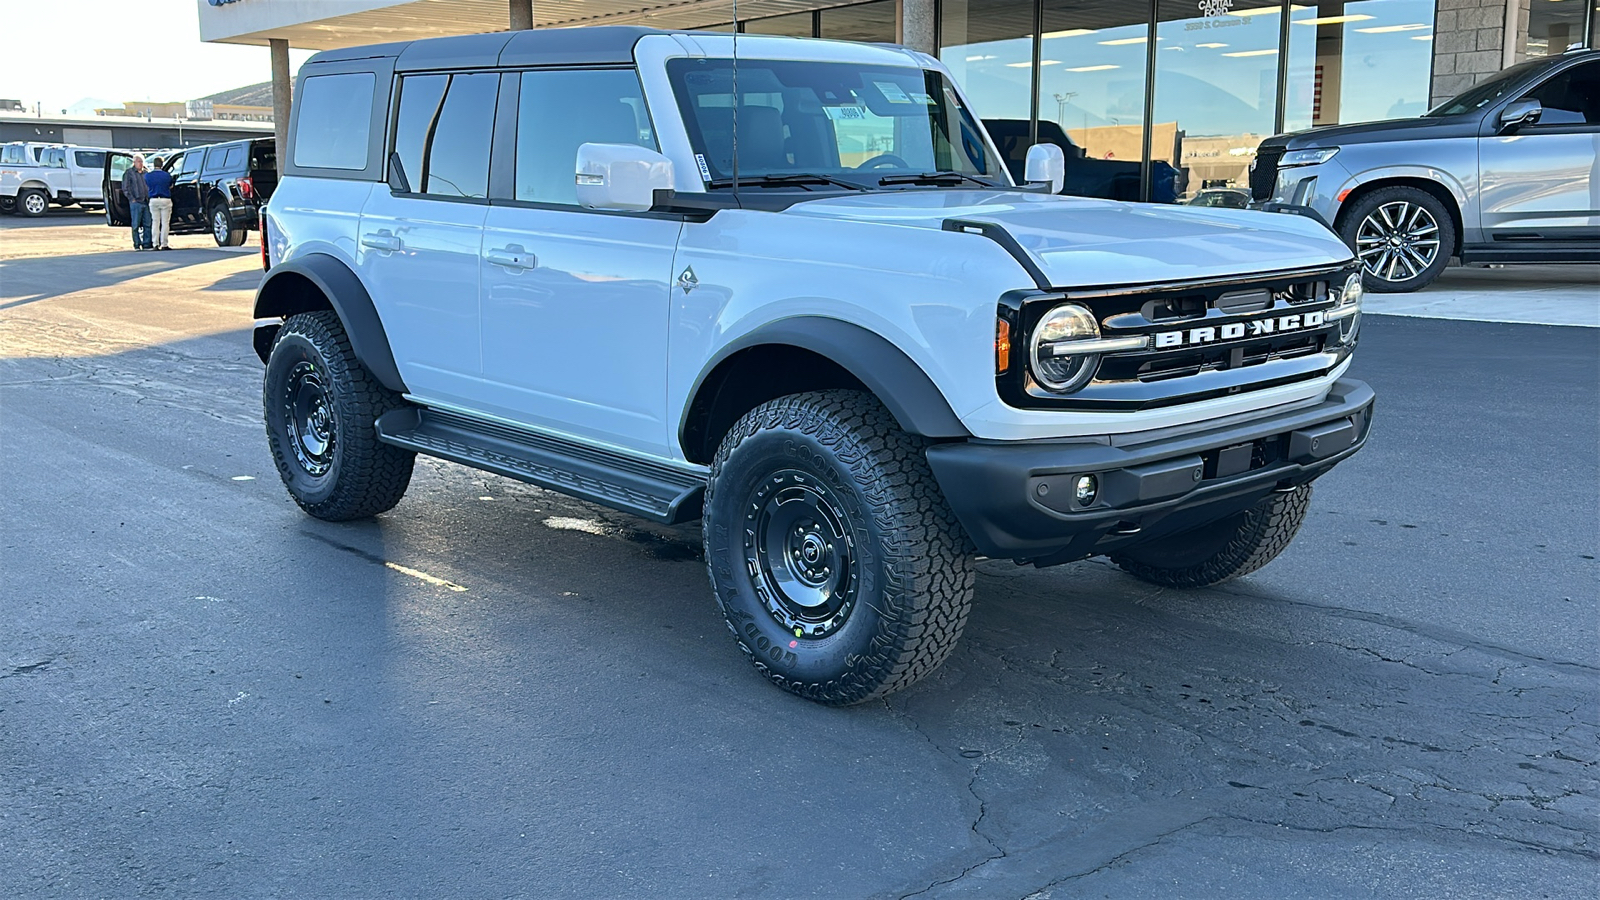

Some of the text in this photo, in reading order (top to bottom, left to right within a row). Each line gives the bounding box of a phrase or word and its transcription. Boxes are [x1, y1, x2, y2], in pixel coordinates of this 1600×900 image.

[1198, 0, 1233, 10] CAPITAL
[1204, 7, 1228, 18] FORD
[1155, 312, 1323, 347] BRONCO
